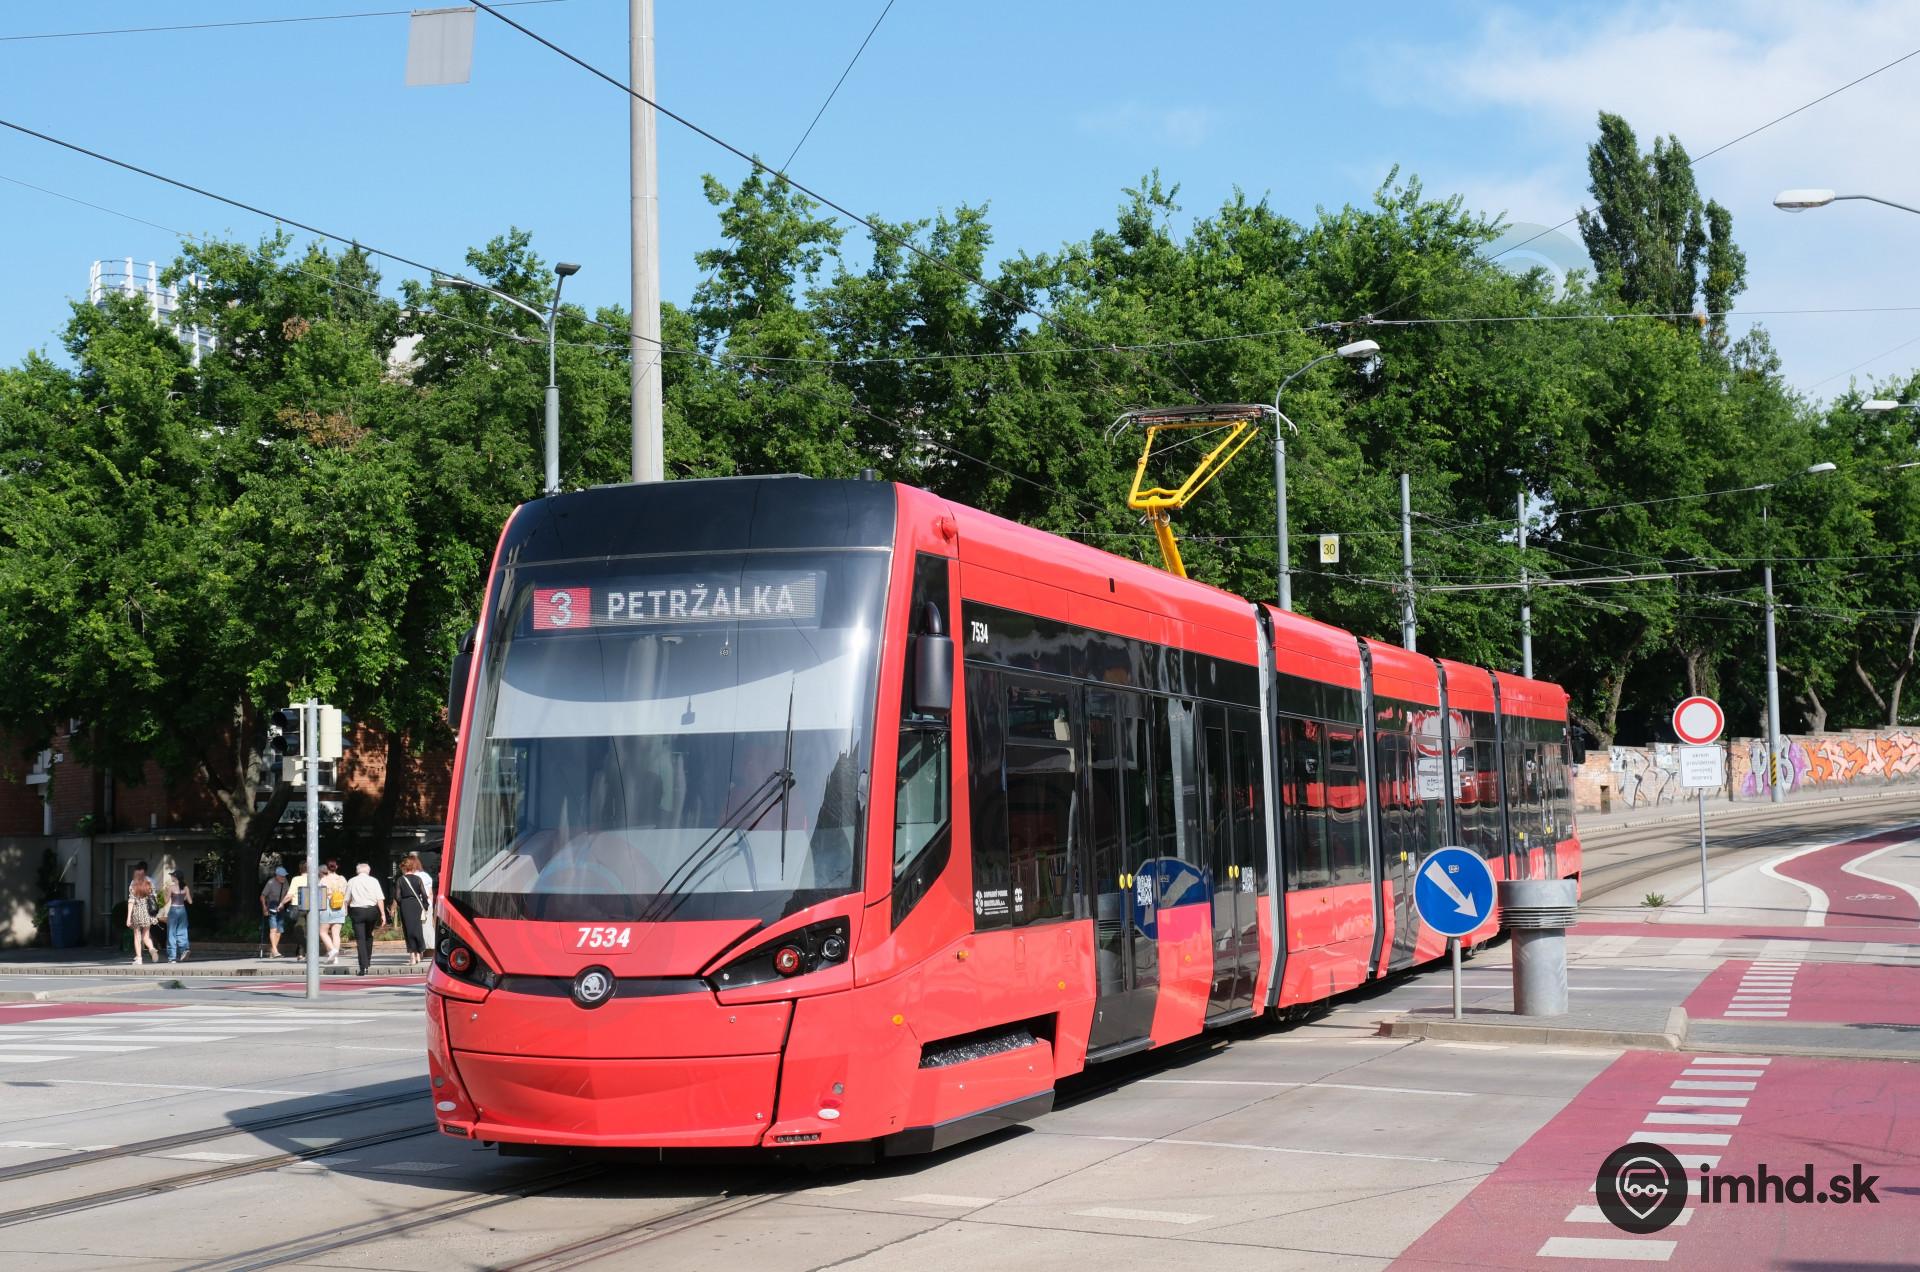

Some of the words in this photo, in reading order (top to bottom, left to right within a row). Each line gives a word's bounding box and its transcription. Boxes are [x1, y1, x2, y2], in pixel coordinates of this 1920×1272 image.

[1323, 543, 1336, 555] 30
[549, 590, 575, 627] 3
[608, 583, 795, 621] PETRŽALKA
[970, 621, 989, 644] 7534
[576, 927, 631, 948] 7534
